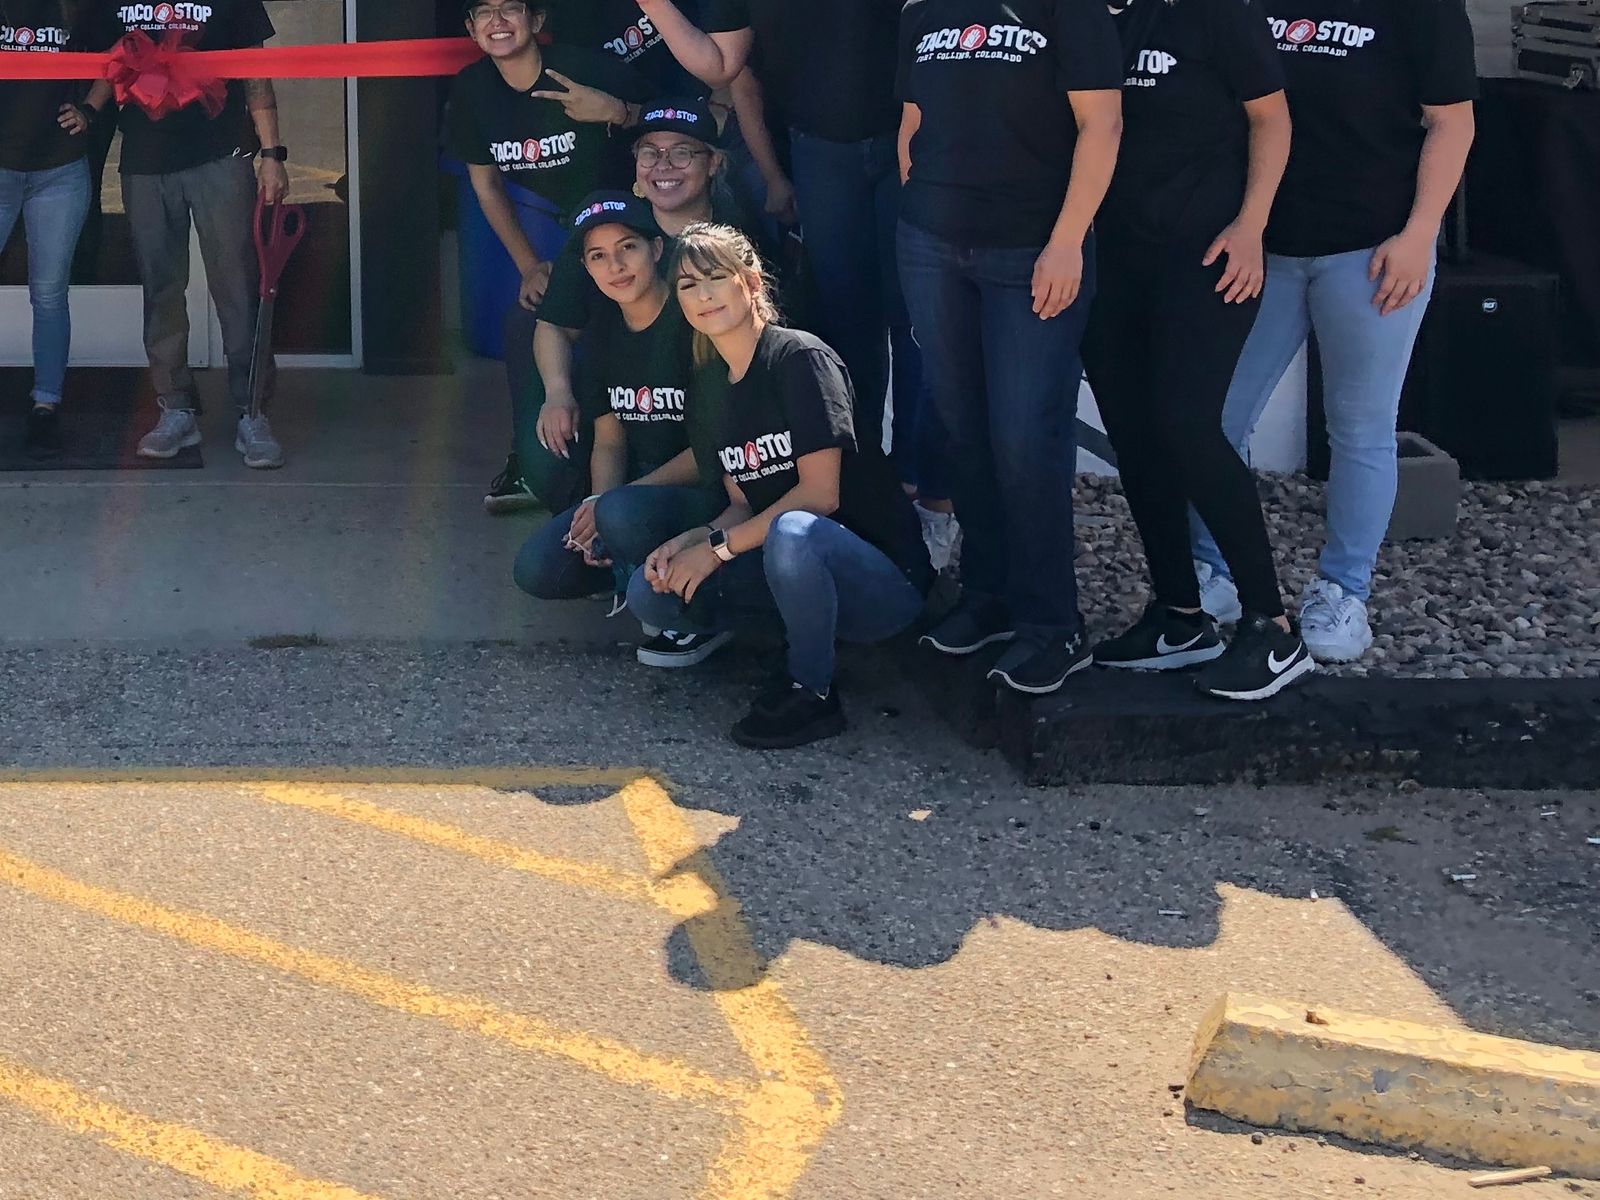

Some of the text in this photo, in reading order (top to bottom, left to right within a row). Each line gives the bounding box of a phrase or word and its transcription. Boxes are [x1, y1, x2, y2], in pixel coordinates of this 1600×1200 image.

[120, 2, 212, 23] TACO STOP
[168, 23, 199, 31] COLORADO
[1316, 20, 1376, 48] STOP
[919, 28, 961, 54] TACO
[936, 51, 972, 61] COLLINS,
[975, 50, 1022, 63] COLORADO
[1302, 44, 1348, 57] COLORADO
[1137, 49, 1178, 74] TOP
[676, 110, 698, 123] STOP
[491, 140, 522, 163] TACO
[539, 131, 576, 157] STOP
[538, 155, 571, 168] COLORADO
[602, 201, 626, 211] STOP
[652, 387, 685, 410] STO
